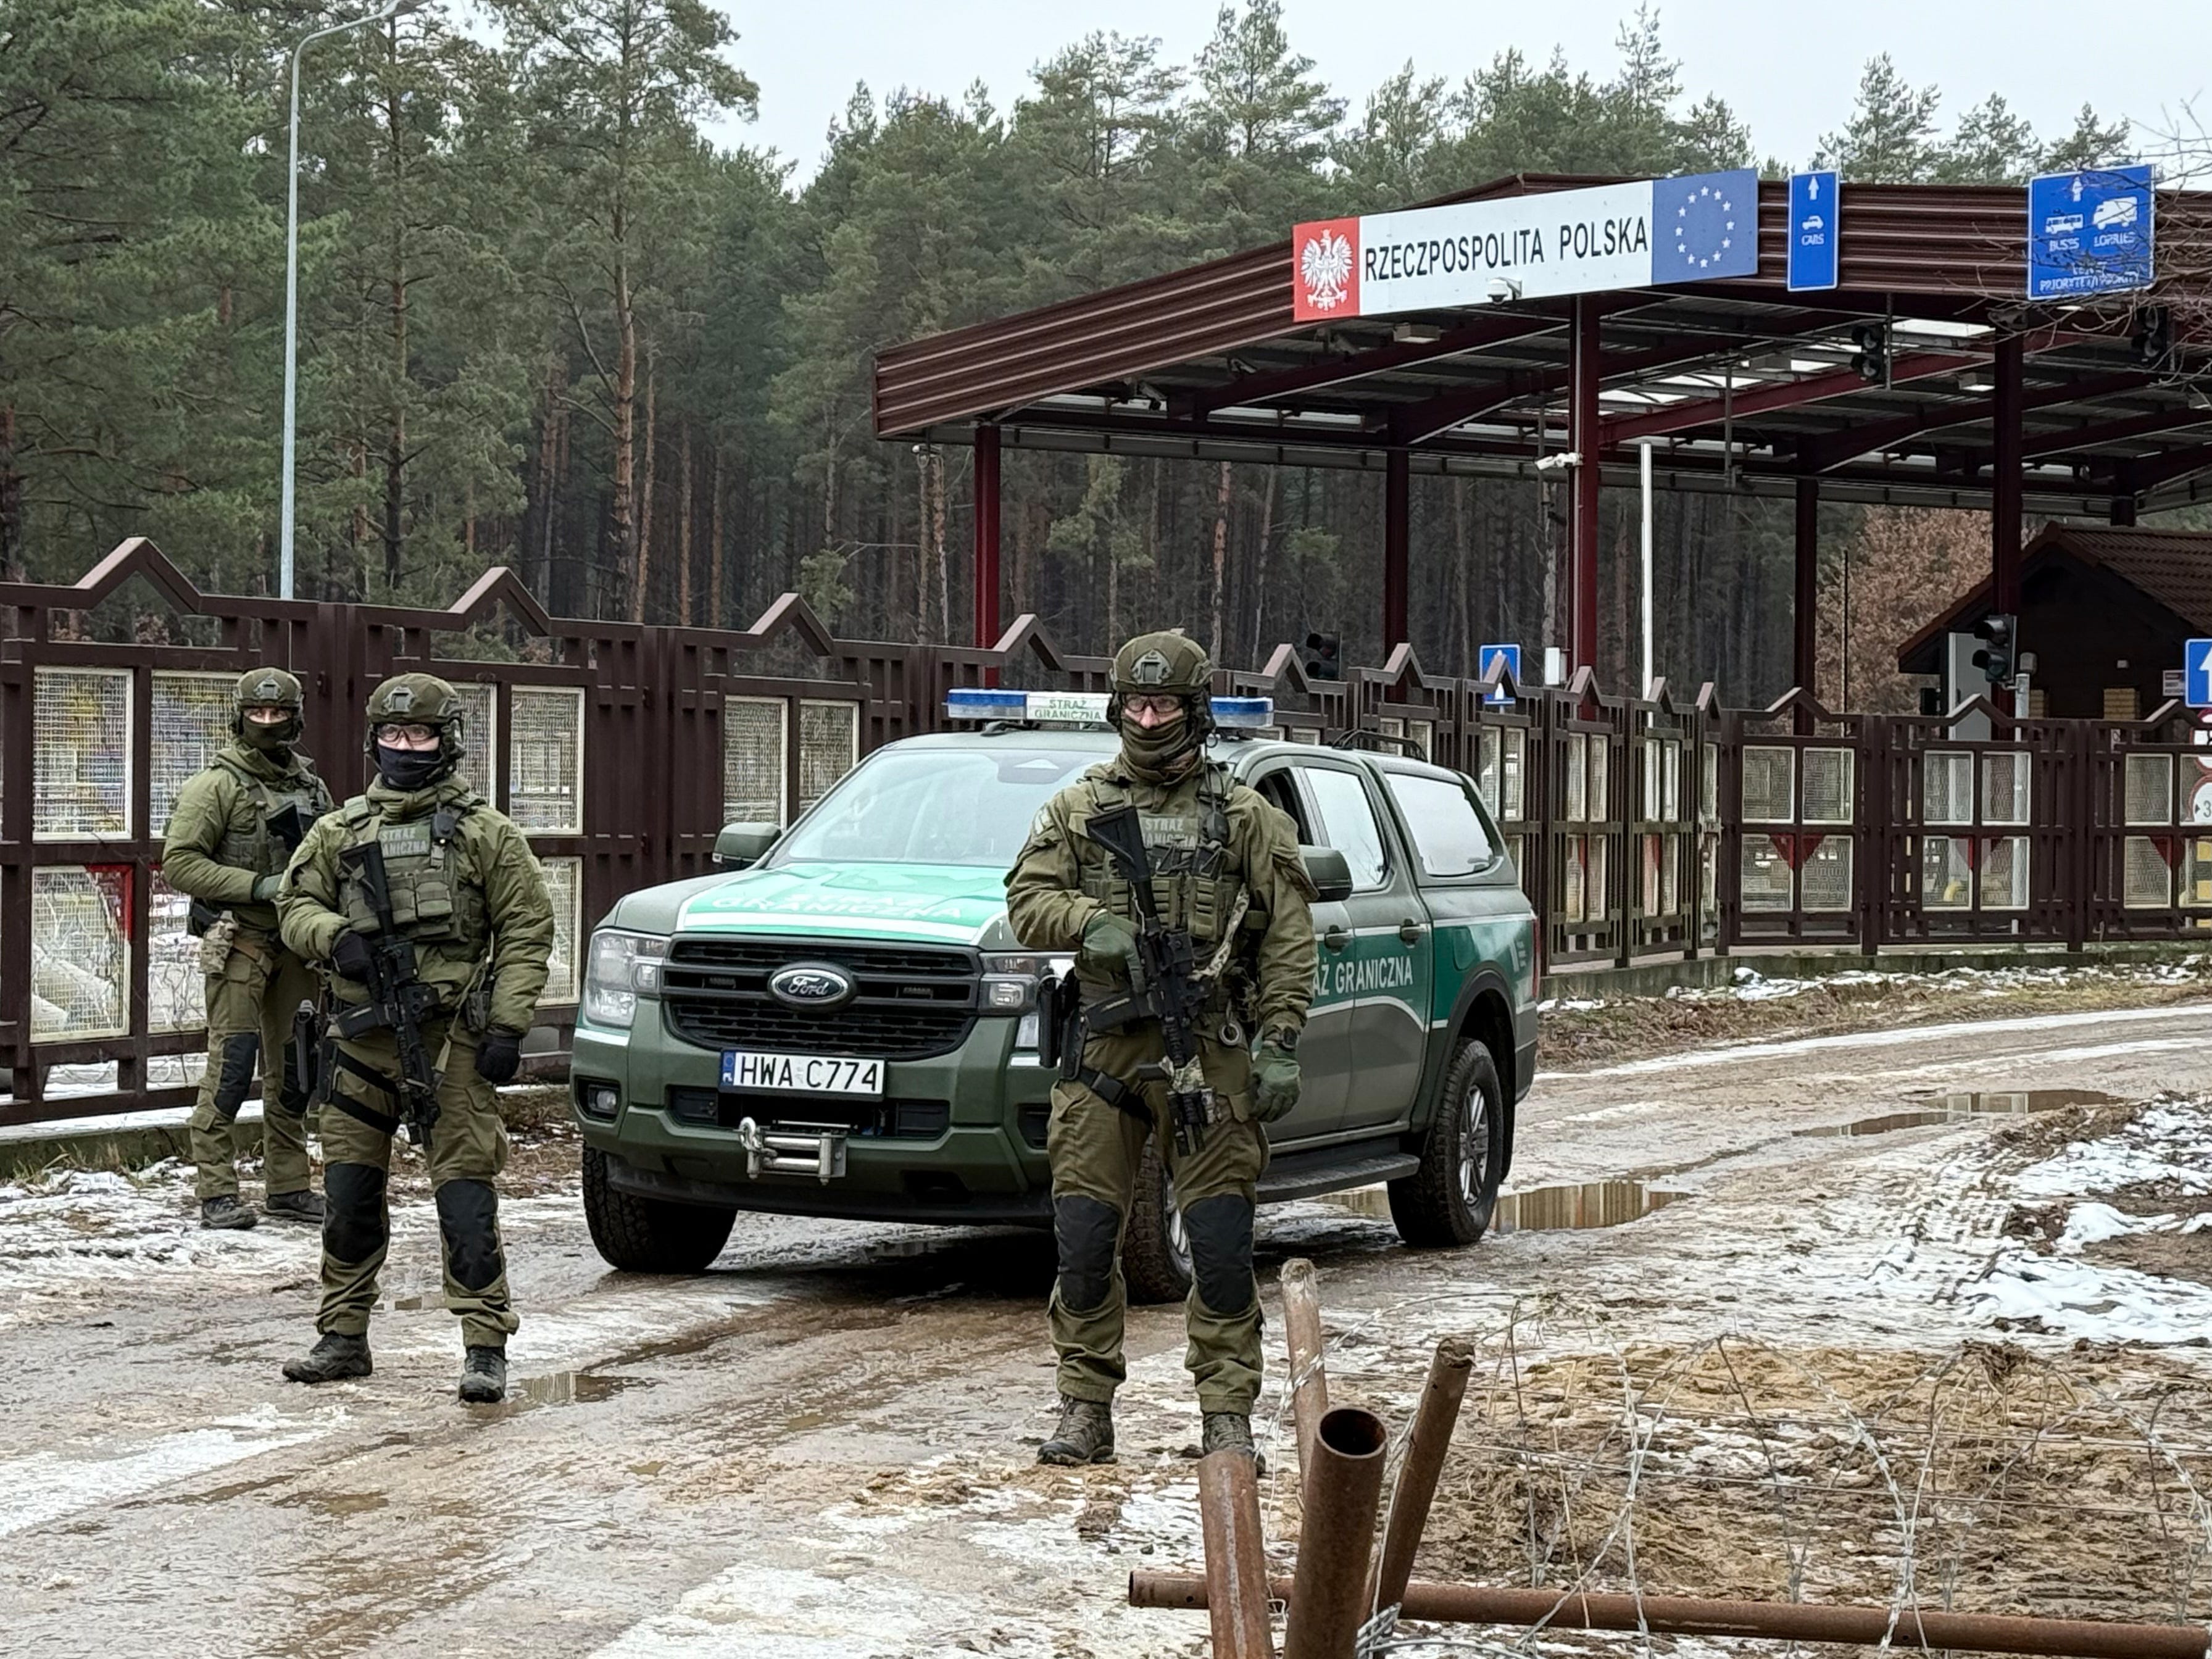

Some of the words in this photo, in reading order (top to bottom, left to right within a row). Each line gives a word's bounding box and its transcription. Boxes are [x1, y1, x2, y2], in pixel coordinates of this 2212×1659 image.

[1365, 227, 1545, 282] RZECZPOSPOLITA
[1560, 216, 1648, 260] POLSKA
[1034, 709, 1102, 720] GRANICZNA
[1049, 699, 1087, 710] STRAŻ
[788, 975, 830, 996] Ford
[1334, 955, 1413, 994] GRANICZNA
[741, 1055, 793, 1087] HWA
[806, 1060, 878, 1092] C774
